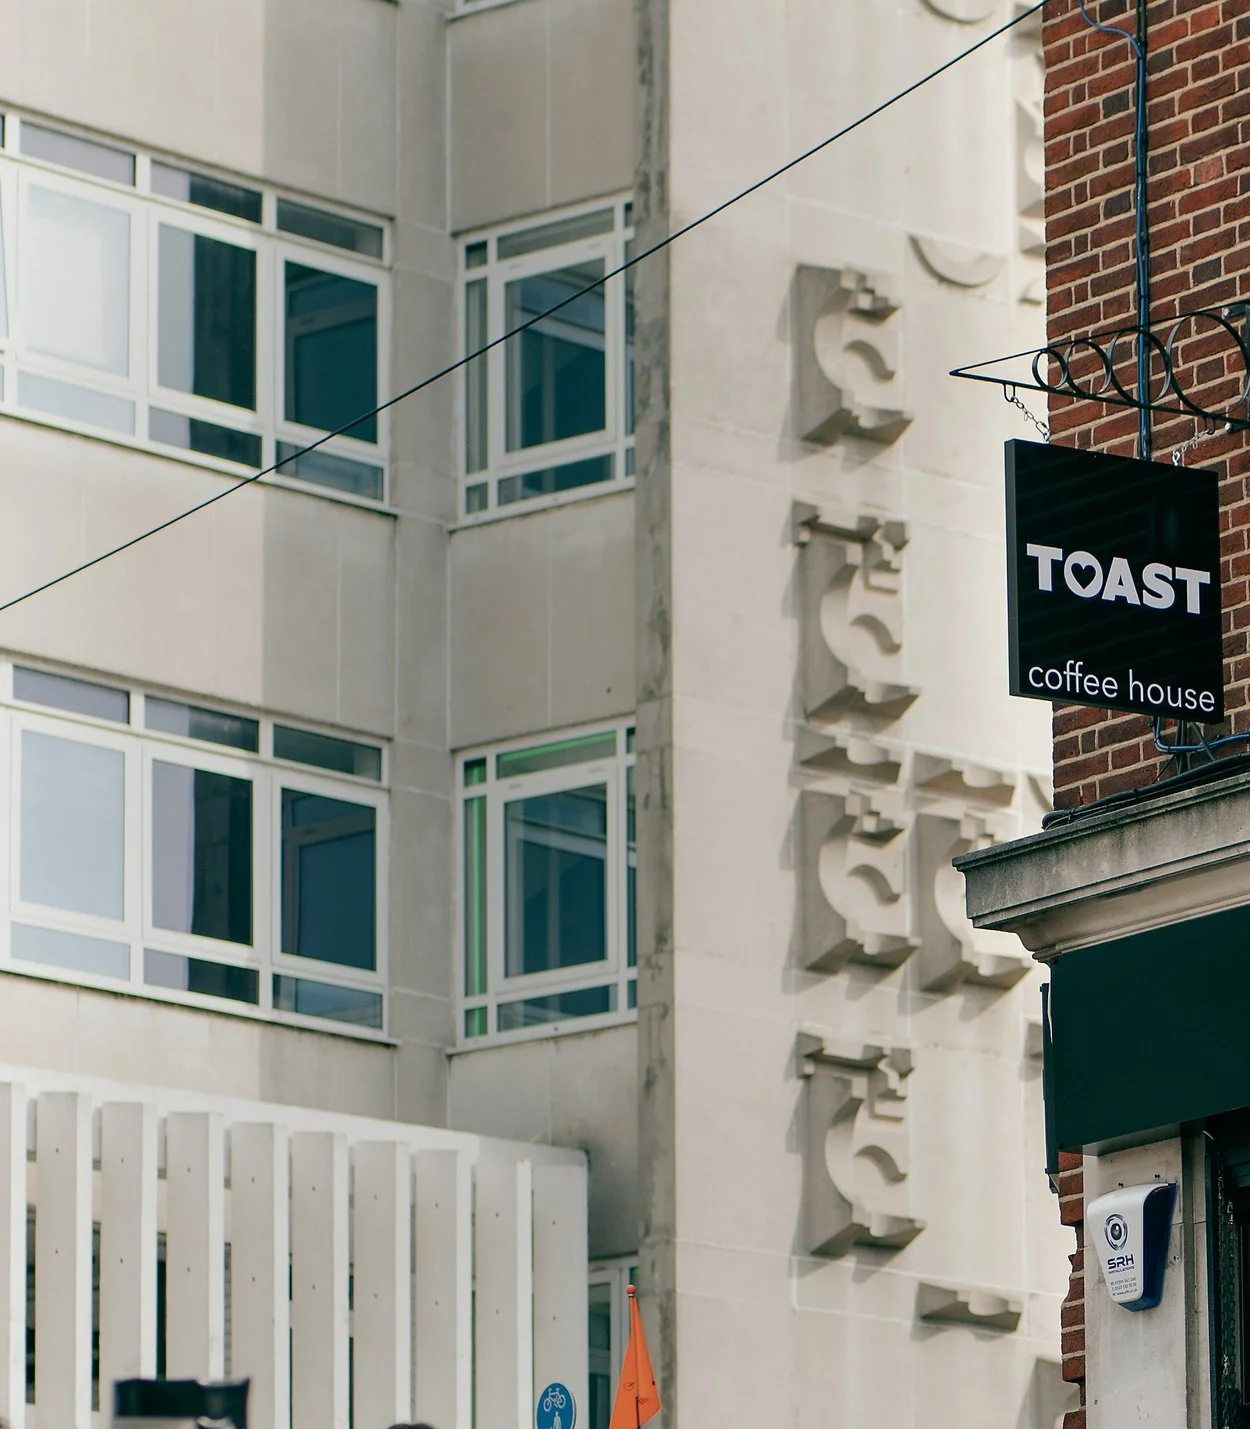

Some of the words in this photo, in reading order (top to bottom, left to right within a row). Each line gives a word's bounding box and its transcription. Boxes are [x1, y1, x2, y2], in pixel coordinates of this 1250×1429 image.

[1026, 543, 1211, 615] TOAST
[1028, 659, 1118, 698] coffee
[1129, 668, 1215, 712] house
[1107, 1253, 1135, 1270] SRH
